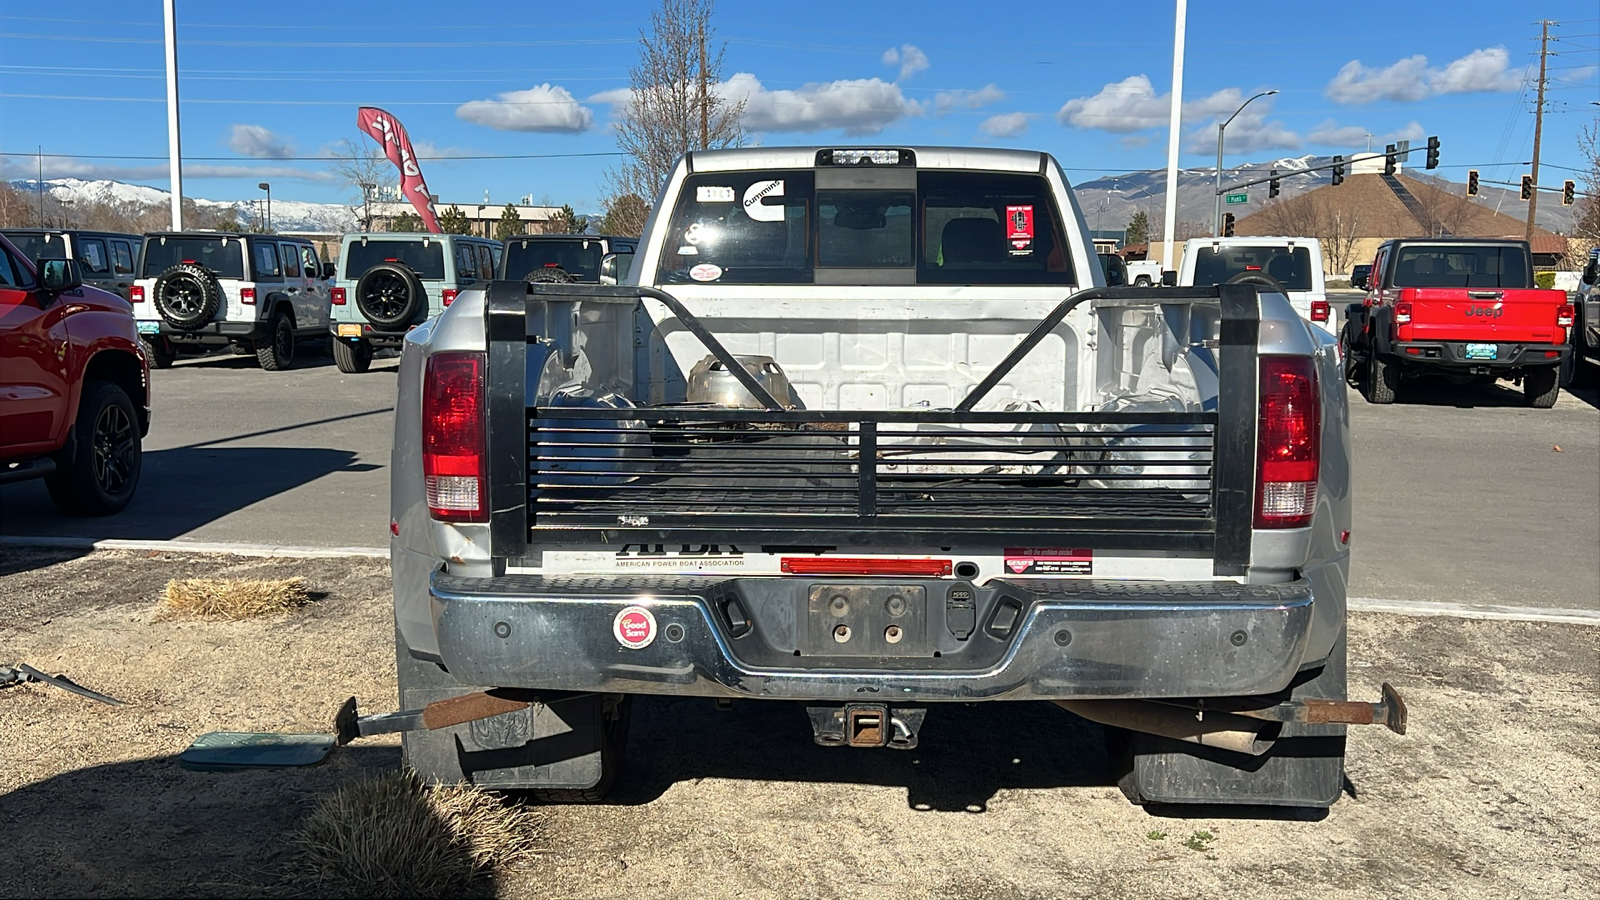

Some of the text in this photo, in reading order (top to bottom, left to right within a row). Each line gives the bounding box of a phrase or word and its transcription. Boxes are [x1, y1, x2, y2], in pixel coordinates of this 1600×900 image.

[744, 180, 780, 207] Cummins
[1464, 304, 1504, 319] Jeep
[623, 620, 647, 629] Good
[626, 629, 645, 637] Sam
